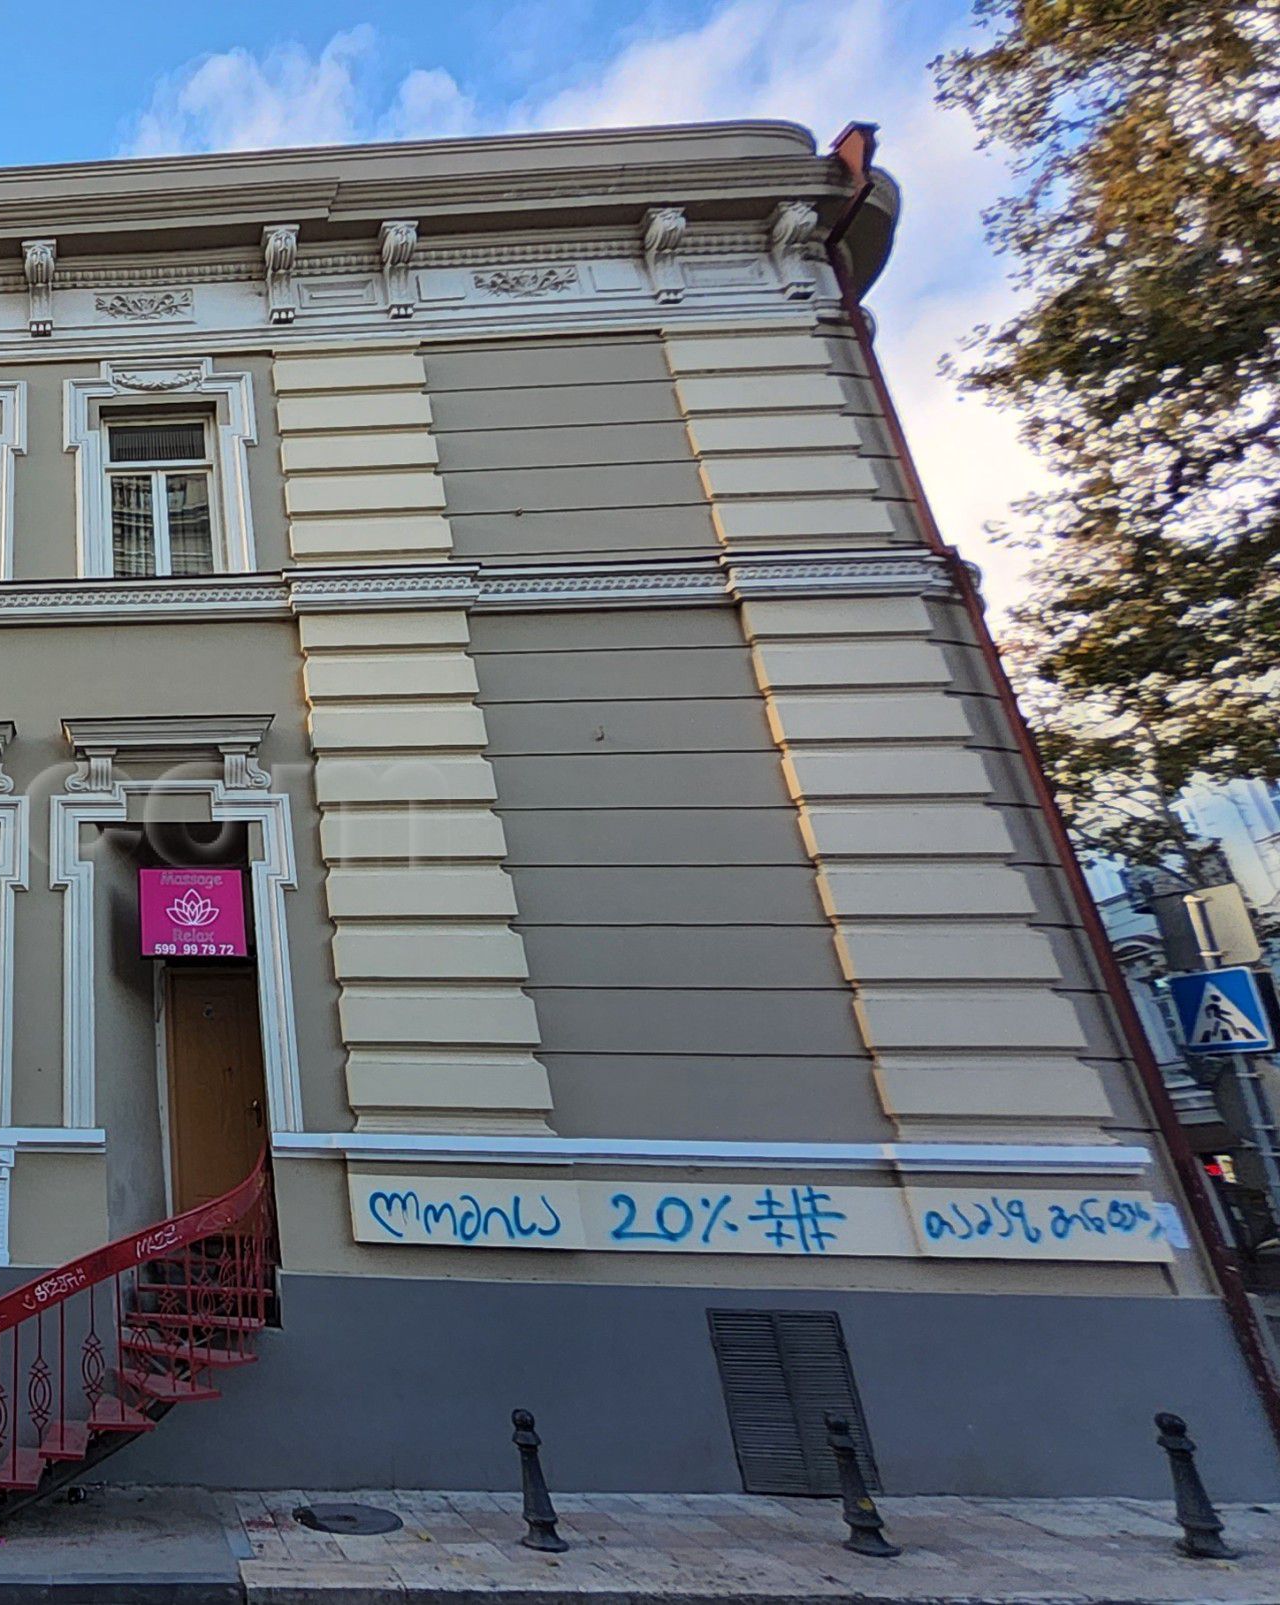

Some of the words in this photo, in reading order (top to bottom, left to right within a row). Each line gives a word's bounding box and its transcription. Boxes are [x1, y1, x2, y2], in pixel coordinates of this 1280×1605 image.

[160, 872, 223, 889] Massage
[173, 928, 214, 942] Relax
[154, 943, 177, 955] 599
[183, 944, 198, 955] 99
[202, 944, 216, 955] 79
[219, 944, 234, 955] 72
[610, 1193, 738, 1242] 20%
